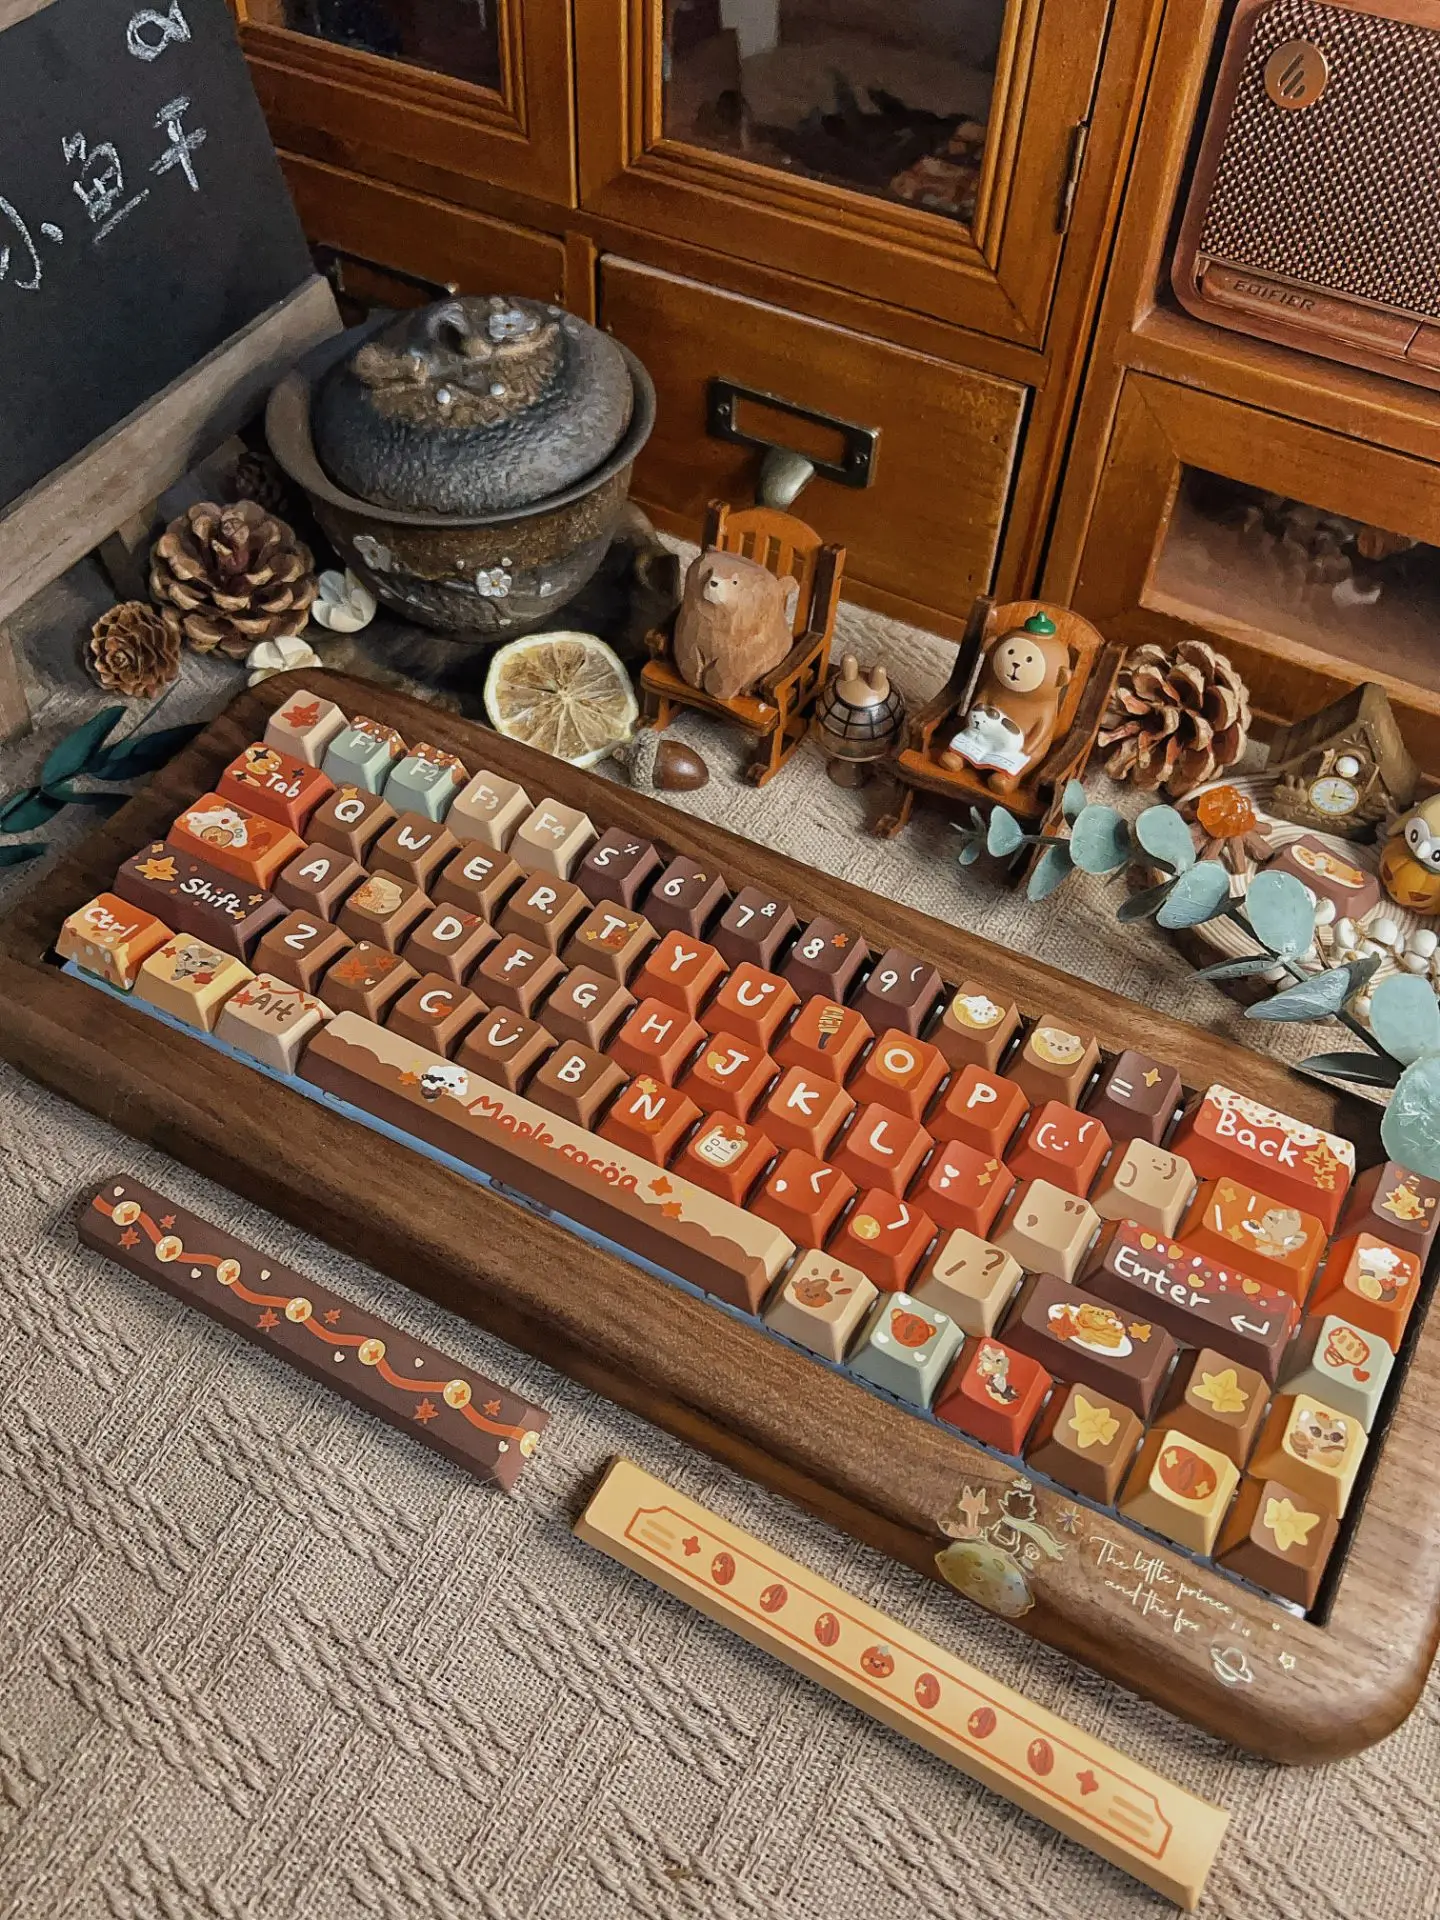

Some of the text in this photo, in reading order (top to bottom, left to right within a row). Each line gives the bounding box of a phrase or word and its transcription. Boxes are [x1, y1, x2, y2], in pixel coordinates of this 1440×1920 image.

[1233, 280, 1315, 311] EDIFIER
[350, 732, 375, 754] F1
[410, 758, 439, 782] F2
[264, 772, 301, 798] Tab
[471, 785, 499, 810] F3
[334, 800, 366, 822] Q
[397, 826, 431, 850] W
[533, 812, 566, 840] F4
[463, 856, 493, 881] E
[593, 848, 619, 866] 5
[299, 859, 331, 883] A
[179, 878, 242, 914] Shift
[663, 877, 685, 896] 6
[84, 908, 138, 943] Ctrl
[432, 916, 463, 941] D
[599, 914, 626, 939] T
[735, 905, 755, 928] 7
[503, 949, 534, 971] F
[670, 945, 697, 972] Y
[802, 938, 825, 959] 8
[880, 970, 898, 992] 9
[252, 993, 292, 1022] Alt
[420, 990, 452, 1013] C
[572, 983, 600, 1009] G
[640, 1013, 673, 1044] H
[557, 1055, 586, 1083] B
[714, 1048, 750, 1076] J
[884, 1048, 915, 1074] O
[630, 1095, 665, 1120] N
[787, 1082, 819, 1115] K
[966, 1082, 997, 1109] P
[467, 1096, 553, 1145] Maple
[869, 1120, 894, 1154] L
[1216, 1108, 1299, 1168] Back
[1114, 1246, 1210, 1308] Enter
[1090, 1536, 1232, 1614] The little prince
[1105, 1580, 1199, 1632] and the fox
